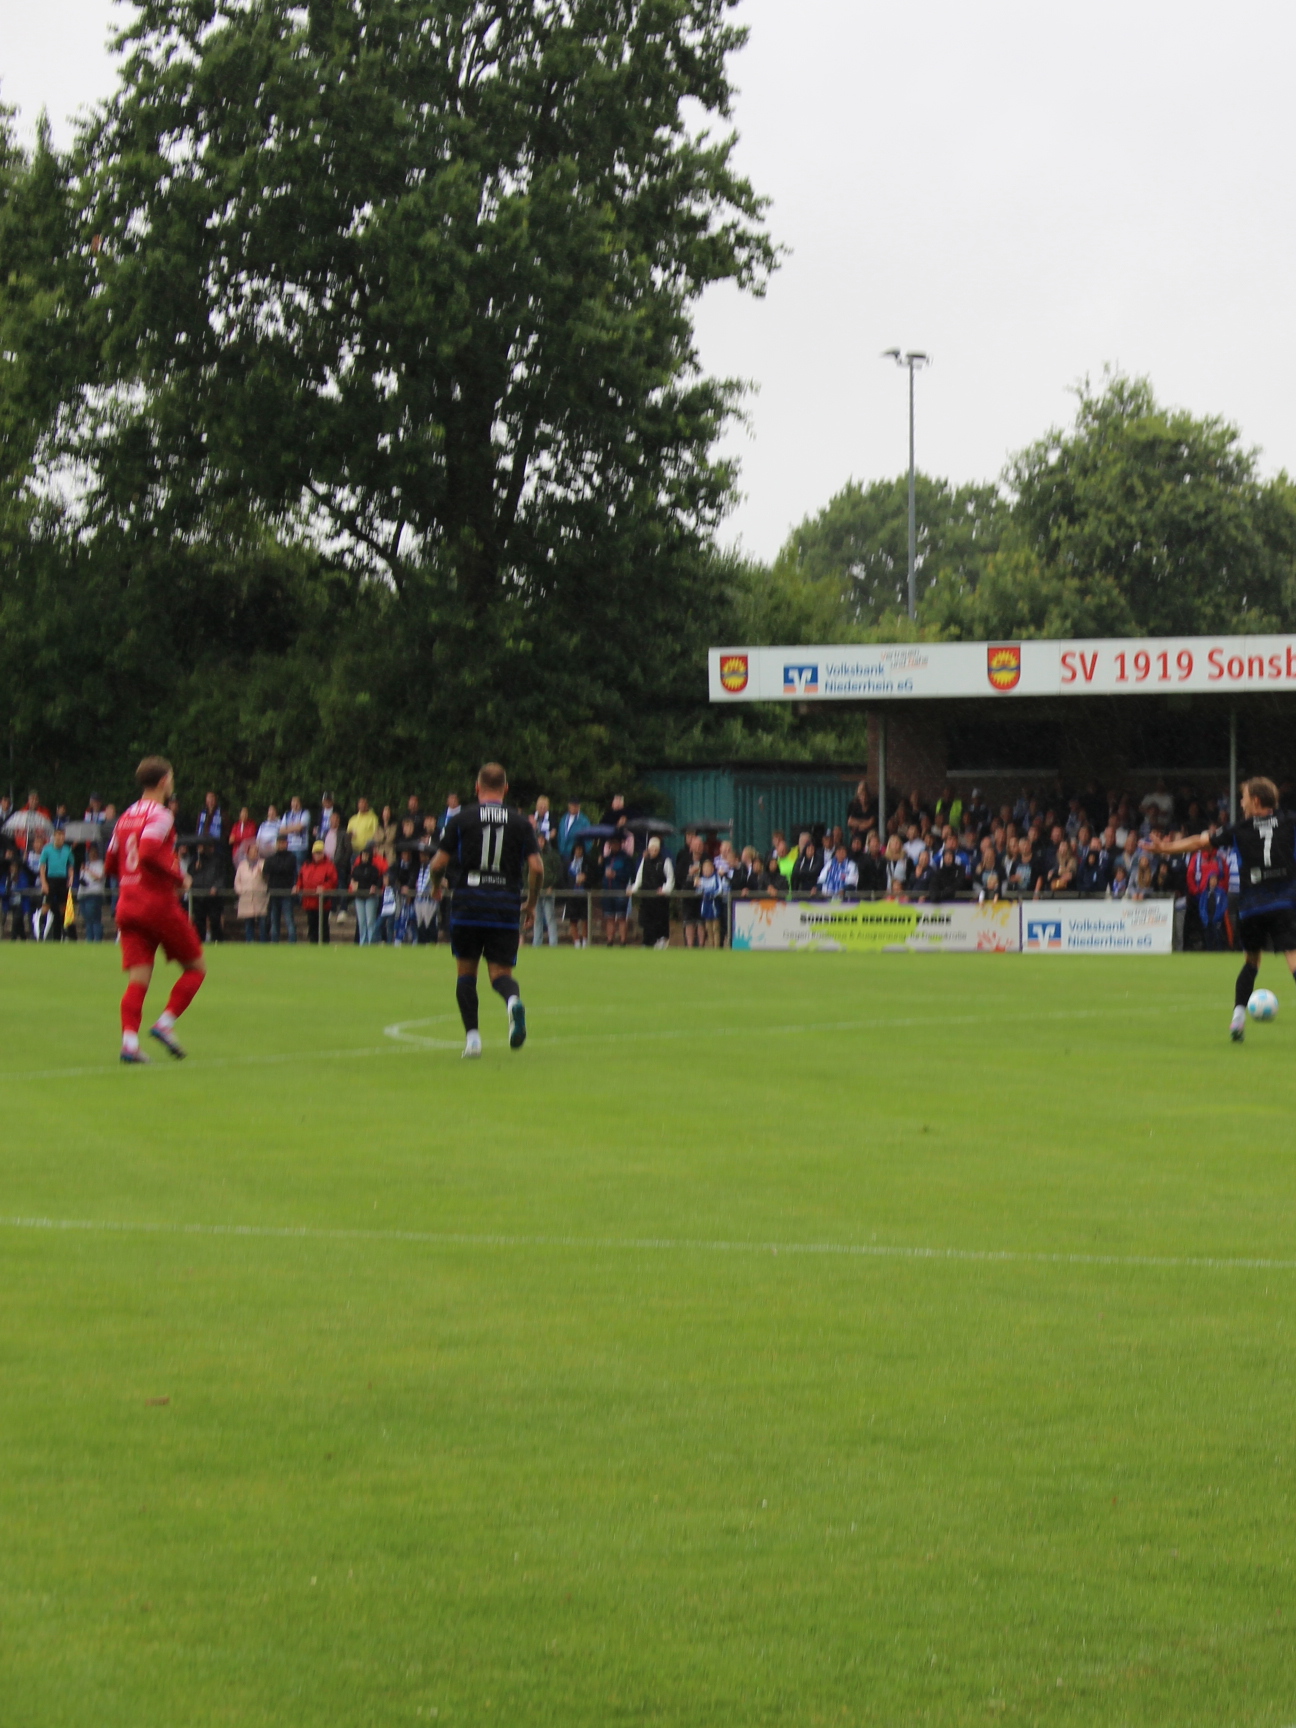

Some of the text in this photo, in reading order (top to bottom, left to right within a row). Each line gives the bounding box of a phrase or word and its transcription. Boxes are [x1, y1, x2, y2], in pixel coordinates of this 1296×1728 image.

[826, 662, 885, 678] Volksbank
[1060, 650, 1098, 684] SV
[1114, 648, 1194, 683] 1919
[825, 678, 894, 694] Niederrhein
[480, 807, 508, 824] DITTGEN
[125, 831, 139, 873] 8
[481, 824, 504, 873] 11
[1258, 826, 1274, 867] 7
[1069, 918, 1126, 932] Volksbank
[1068, 933, 1134, 949] Niederrhein
